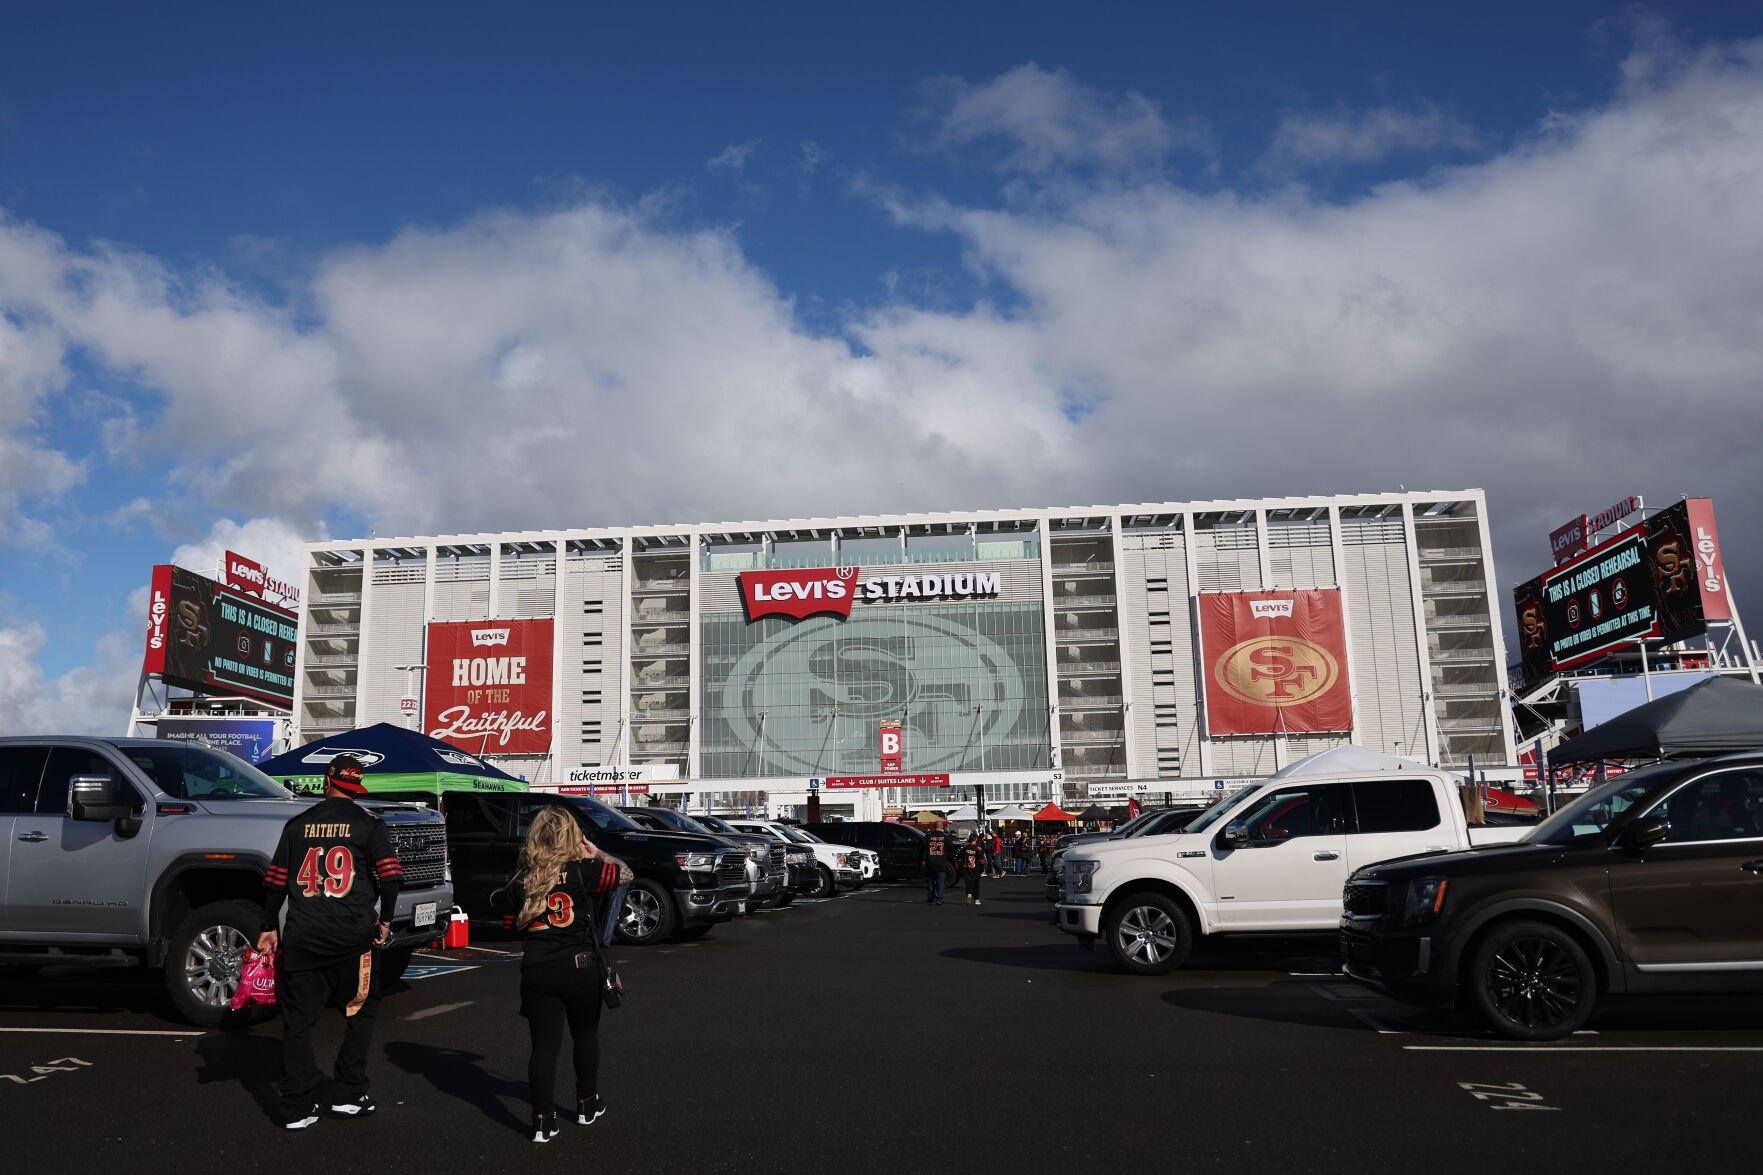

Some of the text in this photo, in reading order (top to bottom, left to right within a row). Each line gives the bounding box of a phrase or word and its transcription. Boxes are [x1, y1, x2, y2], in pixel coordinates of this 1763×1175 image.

[1588, 496, 1636, 533] STADIUM
[231, 561, 265, 585] Levi's
[1549, 546, 1641, 603] THIS IS A CLOSED REHEARSAL
[754, 579, 847, 601] Levi's
[865, 572, 1001, 599] STADIUM
[221, 602, 237, 622] THIS
[238, 611, 246, 625] IS
[246, 612, 252, 627] A
[253, 614, 277, 636] CLOSED
[1255, 604, 1289, 612] Levi's
[1579, 628, 1592, 643] VIDEO
[1597, 617, 1620, 636] PERMITTED
[1627, 610, 1638, 624] THIS
[1638, 605, 1652, 619] TIME
[475, 633, 505, 641] Levi's
[214, 656, 293, 687] NO PHOTO OR VIDEO IS PERMITTED AT
[452, 657, 526, 687] HOME
[402, 700, 411, 708] 22
[467, 689, 510, 704] OF THE
[429, 706, 547, 745] Faithful
[882, 733, 900, 754] B
[473, 779, 505, 792] SEAHAWKS
[570, 769, 642, 782] ticketmaser
[304, 823, 351, 838] FAITHFUL
[929, 841, 944, 856] 23
[297, 846, 356, 898] 49
